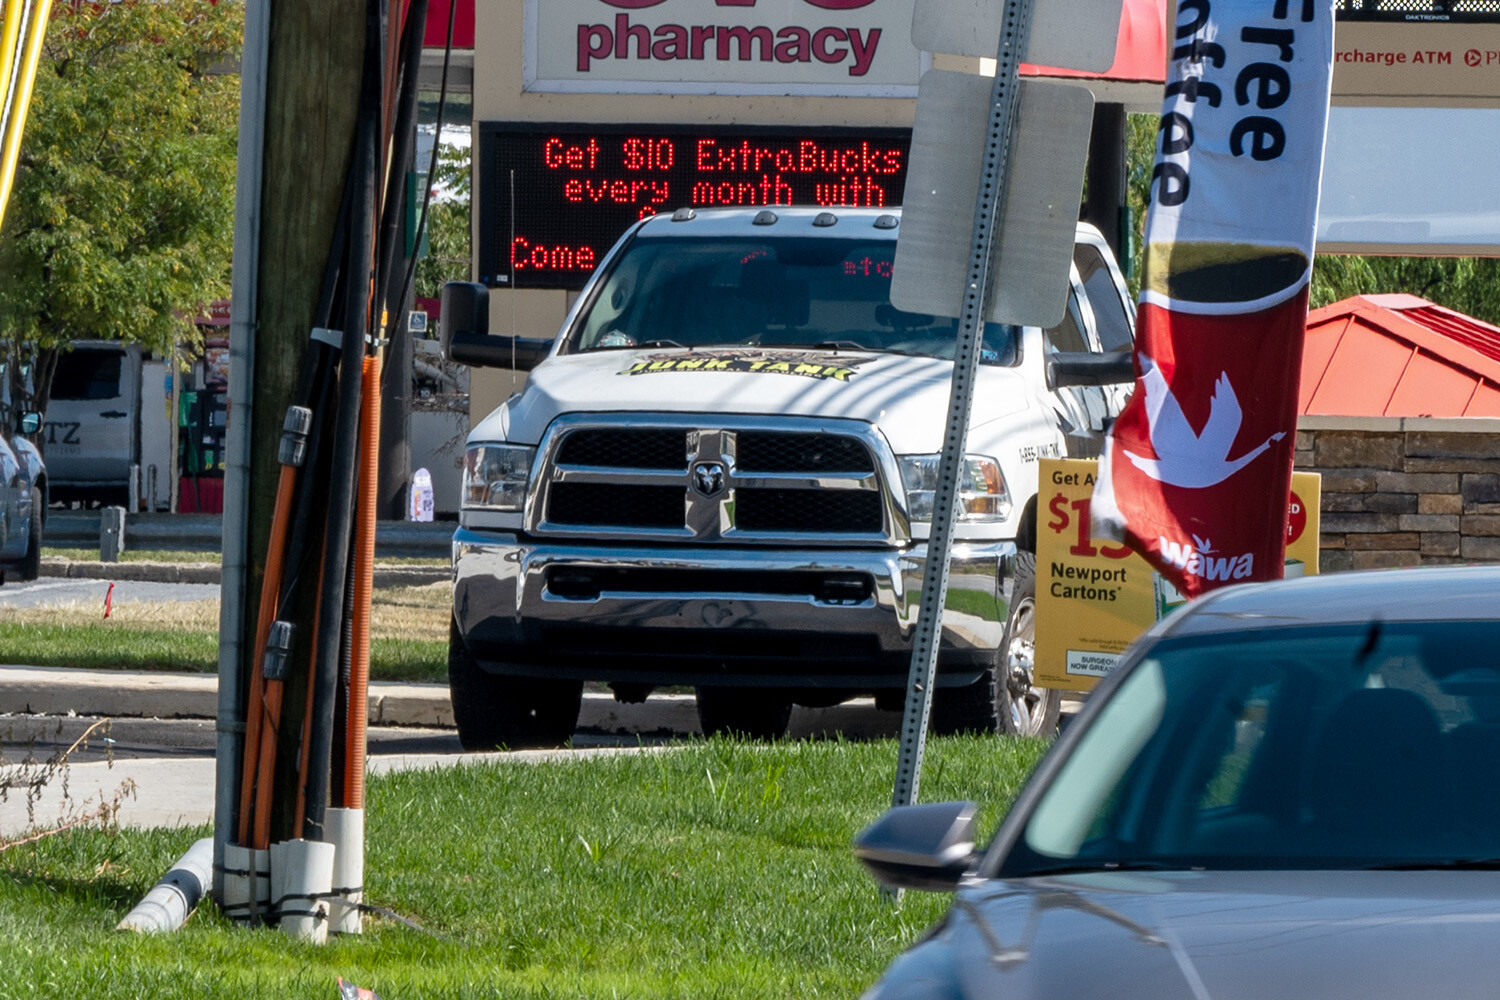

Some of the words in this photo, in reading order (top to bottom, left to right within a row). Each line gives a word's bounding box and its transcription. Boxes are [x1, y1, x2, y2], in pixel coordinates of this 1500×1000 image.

[576, 12, 883, 76] pharmacy
[1335, 49, 1407, 66] rcharge
[1412, 51, 1452, 64] ATM
[544, 138, 600, 170] Get
[623, 138, 675, 171] $10
[697, 139, 901, 174] ExtraBucks
[564, 178, 669, 204] every
[692, 174, 792, 207] month
[815, 175, 885, 207] with
[510, 237, 595, 270] Come
[623, 359, 734, 375] JUNK
[750, 360, 858, 381] TANK
[1052, 471, 1079, 486] Get
[1159, 536, 1254, 582] Wawa
[1051, 562, 1127, 584] Newport
[1070, 662, 1088, 670] NOW
